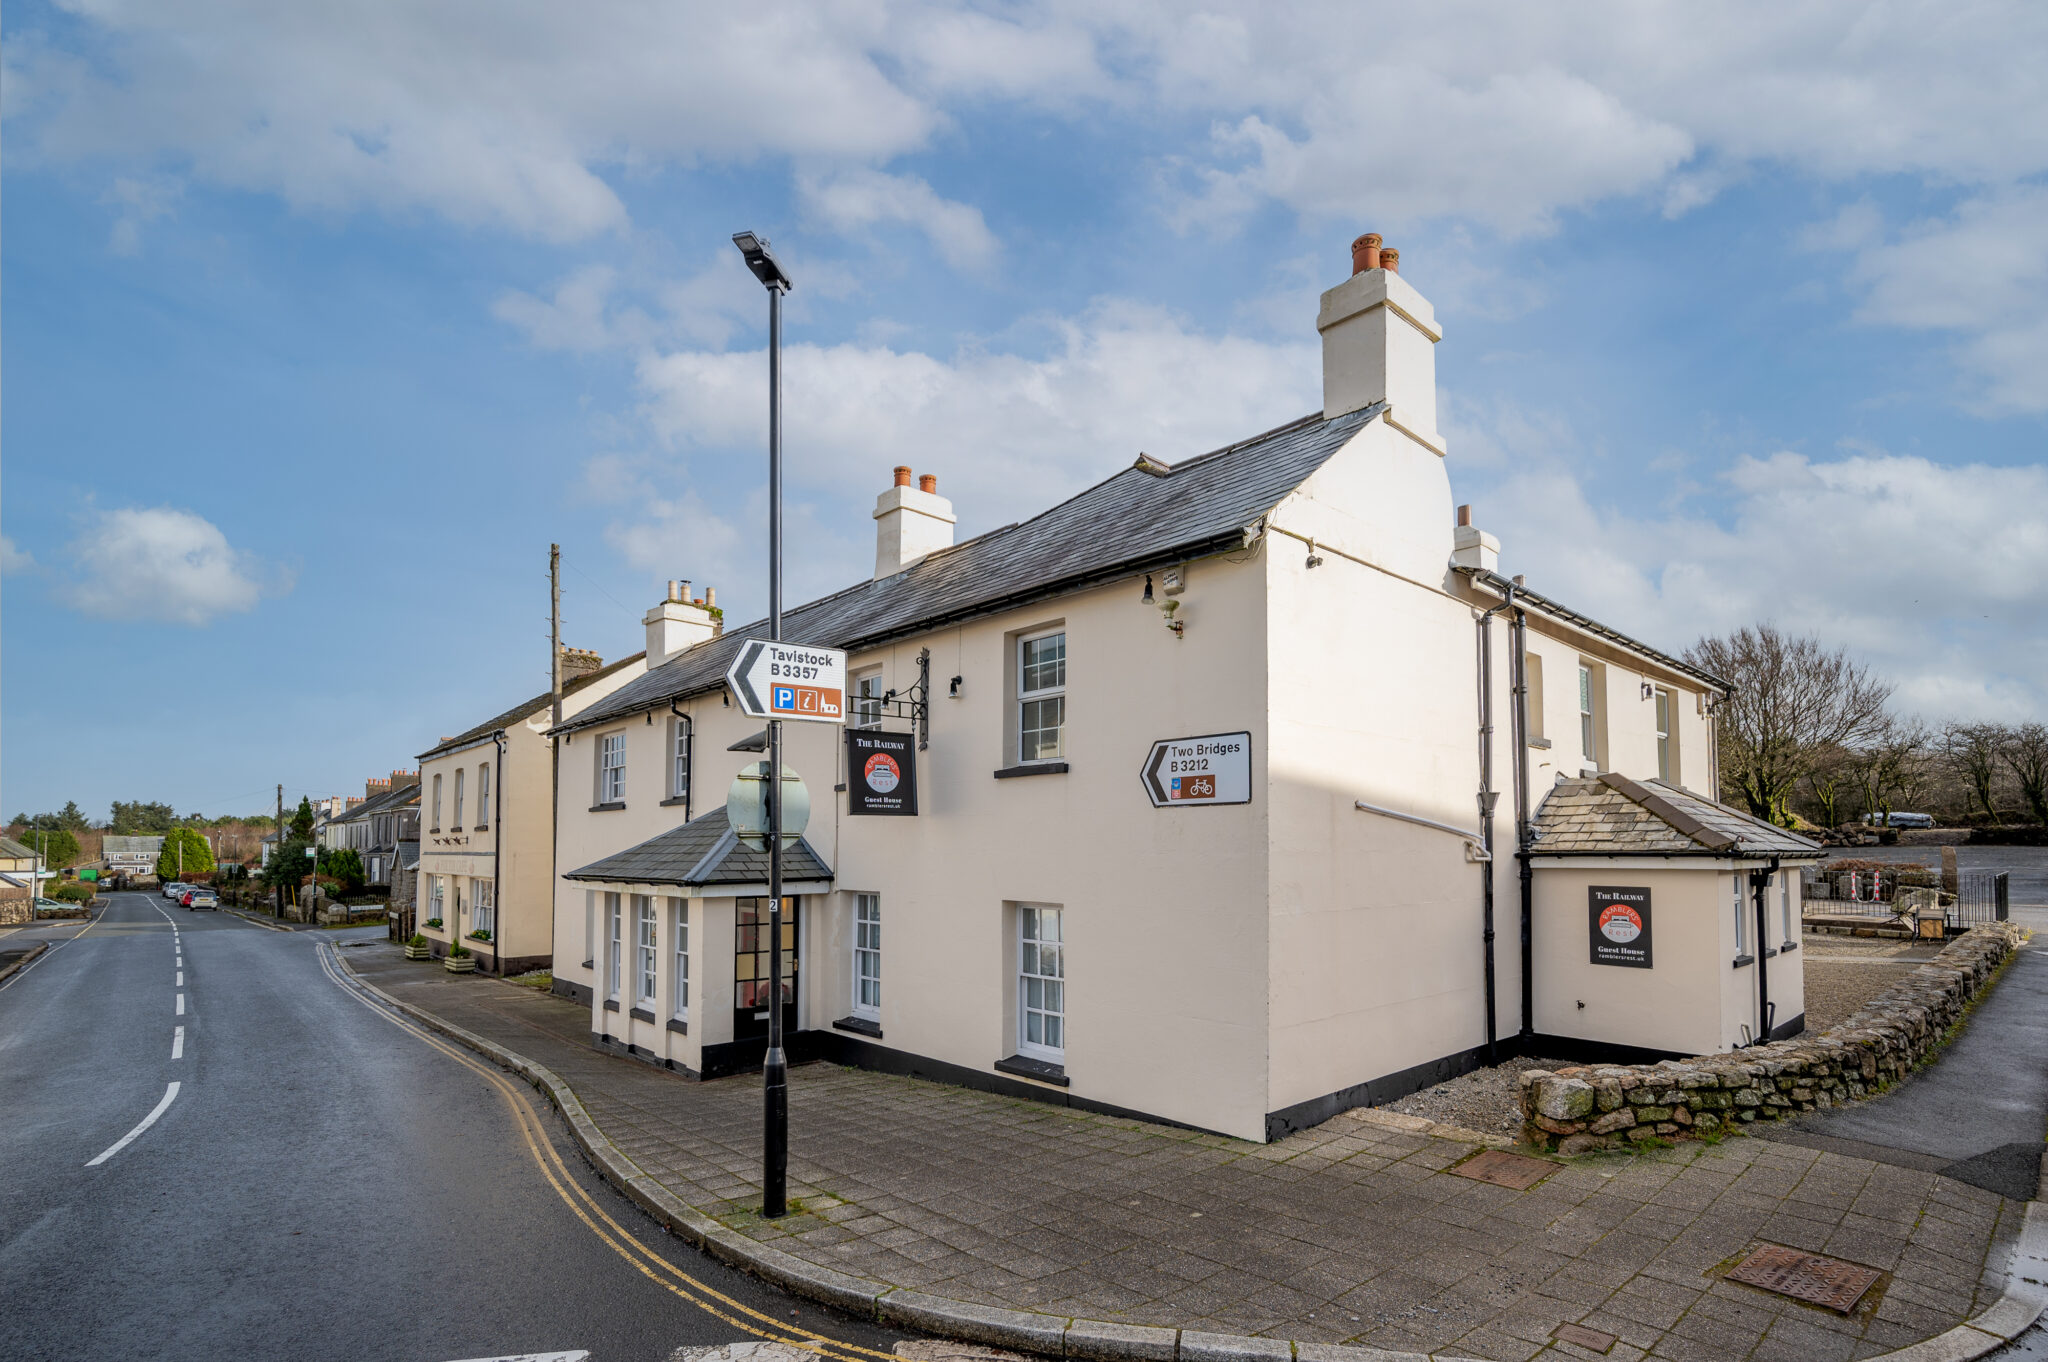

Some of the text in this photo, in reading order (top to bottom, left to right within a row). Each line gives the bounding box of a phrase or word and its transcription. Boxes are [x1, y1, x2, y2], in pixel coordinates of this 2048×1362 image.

[770, 647, 833, 666] Tavistock
[771, 663, 818, 680] B 3357
[779, 689, 792, 707] P
[857, 738, 904, 749] THE RAILWAY
[1171, 743, 1240, 757] Two Bridges
[1171, 759, 1208, 772] B 3212
[873, 778, 893, 786] Rest
[1596, 892, 1644, 901] THE RAILWAY
[770, 900, 776, 910] 2
[1608, 929, 1633, 937] Rest
[1598, 946, 1619, 954] Guest
